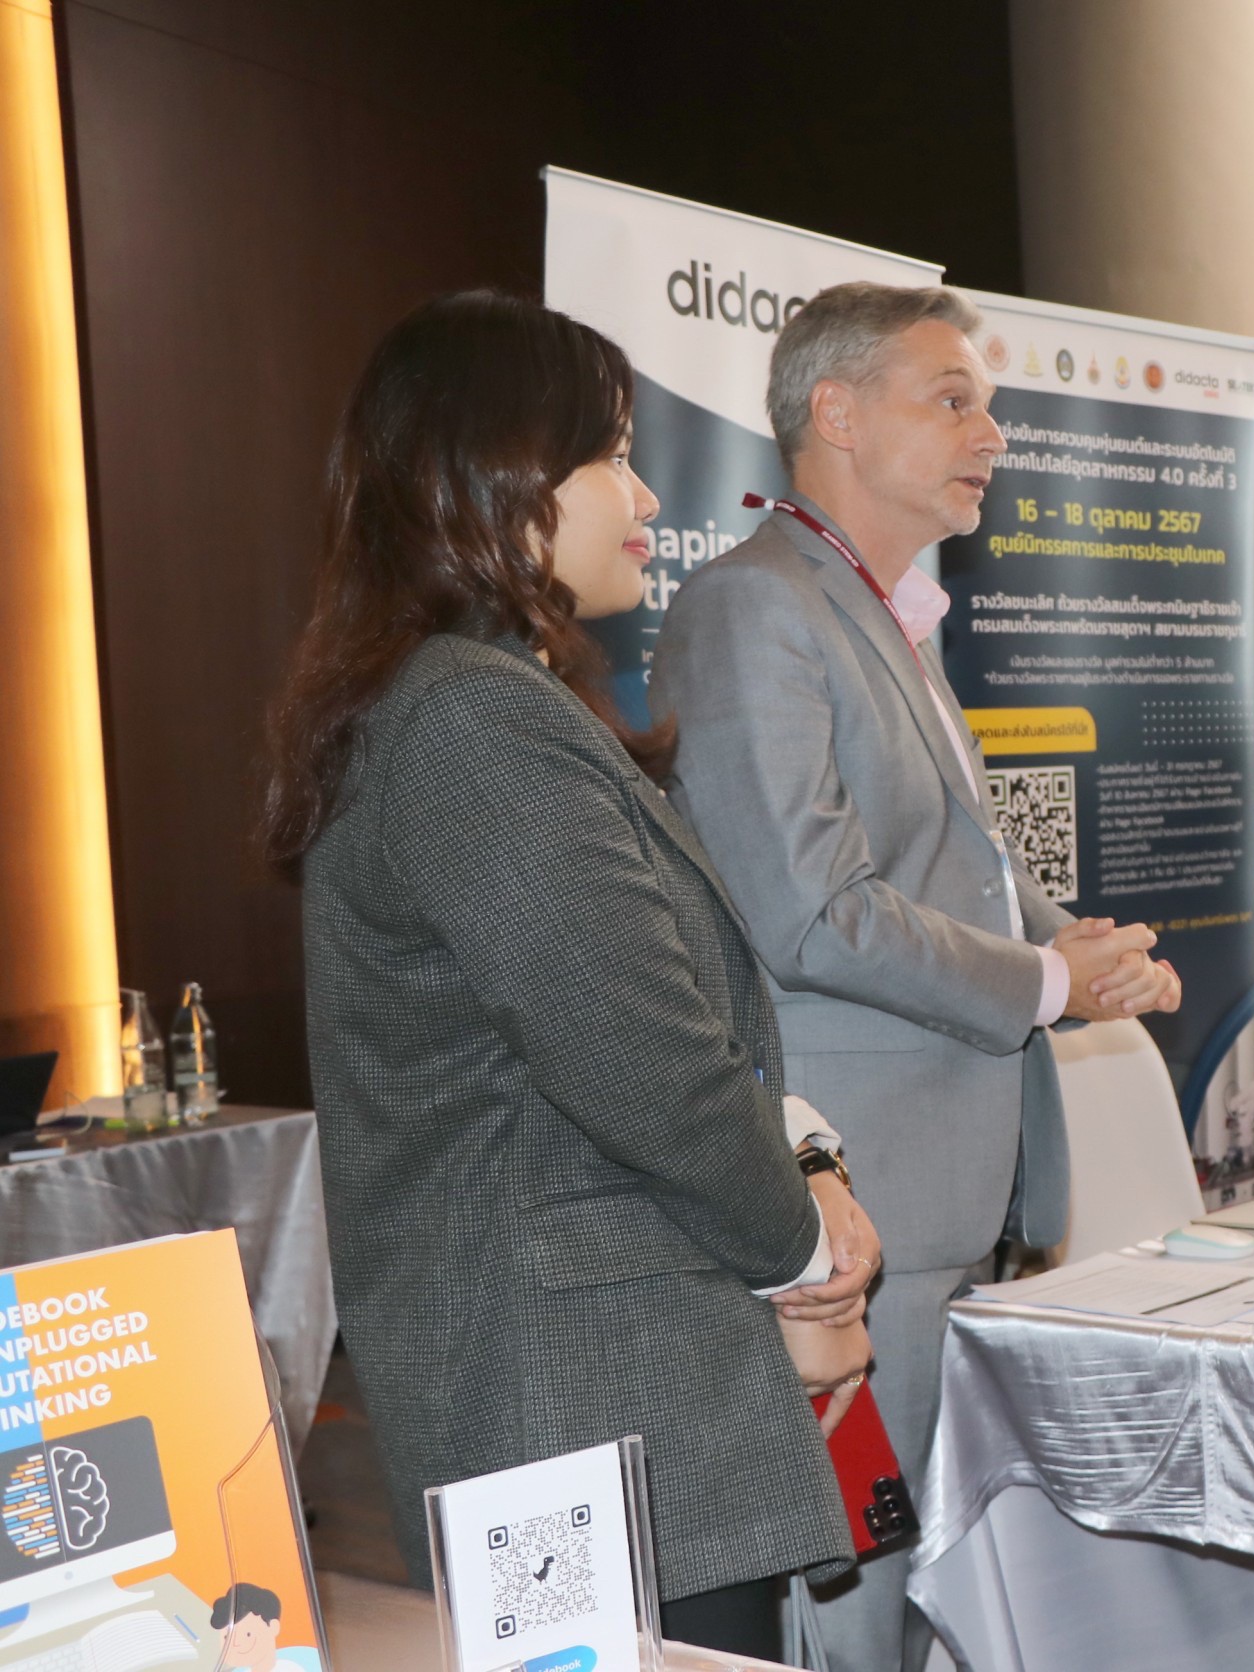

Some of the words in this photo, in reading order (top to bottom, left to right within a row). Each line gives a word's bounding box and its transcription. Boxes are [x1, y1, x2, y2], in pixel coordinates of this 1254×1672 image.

[1160, 466, 1184, 486] 4.0
[1188, 462, 1225, 489] ครั้งที่
[1228, 473, 1237, 490] 3
[1016, 499, 1039, 523] 16
[1064, 502, 1084, 526] 18
[1089, 507, 1151, 534] ตุลาคม
[1158, 510, 1201, 533] 2567
[989, 530, 1226, 567] ศูนย์นิทรรศการและการประชุมไบเทค
[971, 591, 1055, 610] รางวัลชนะเลิศ
